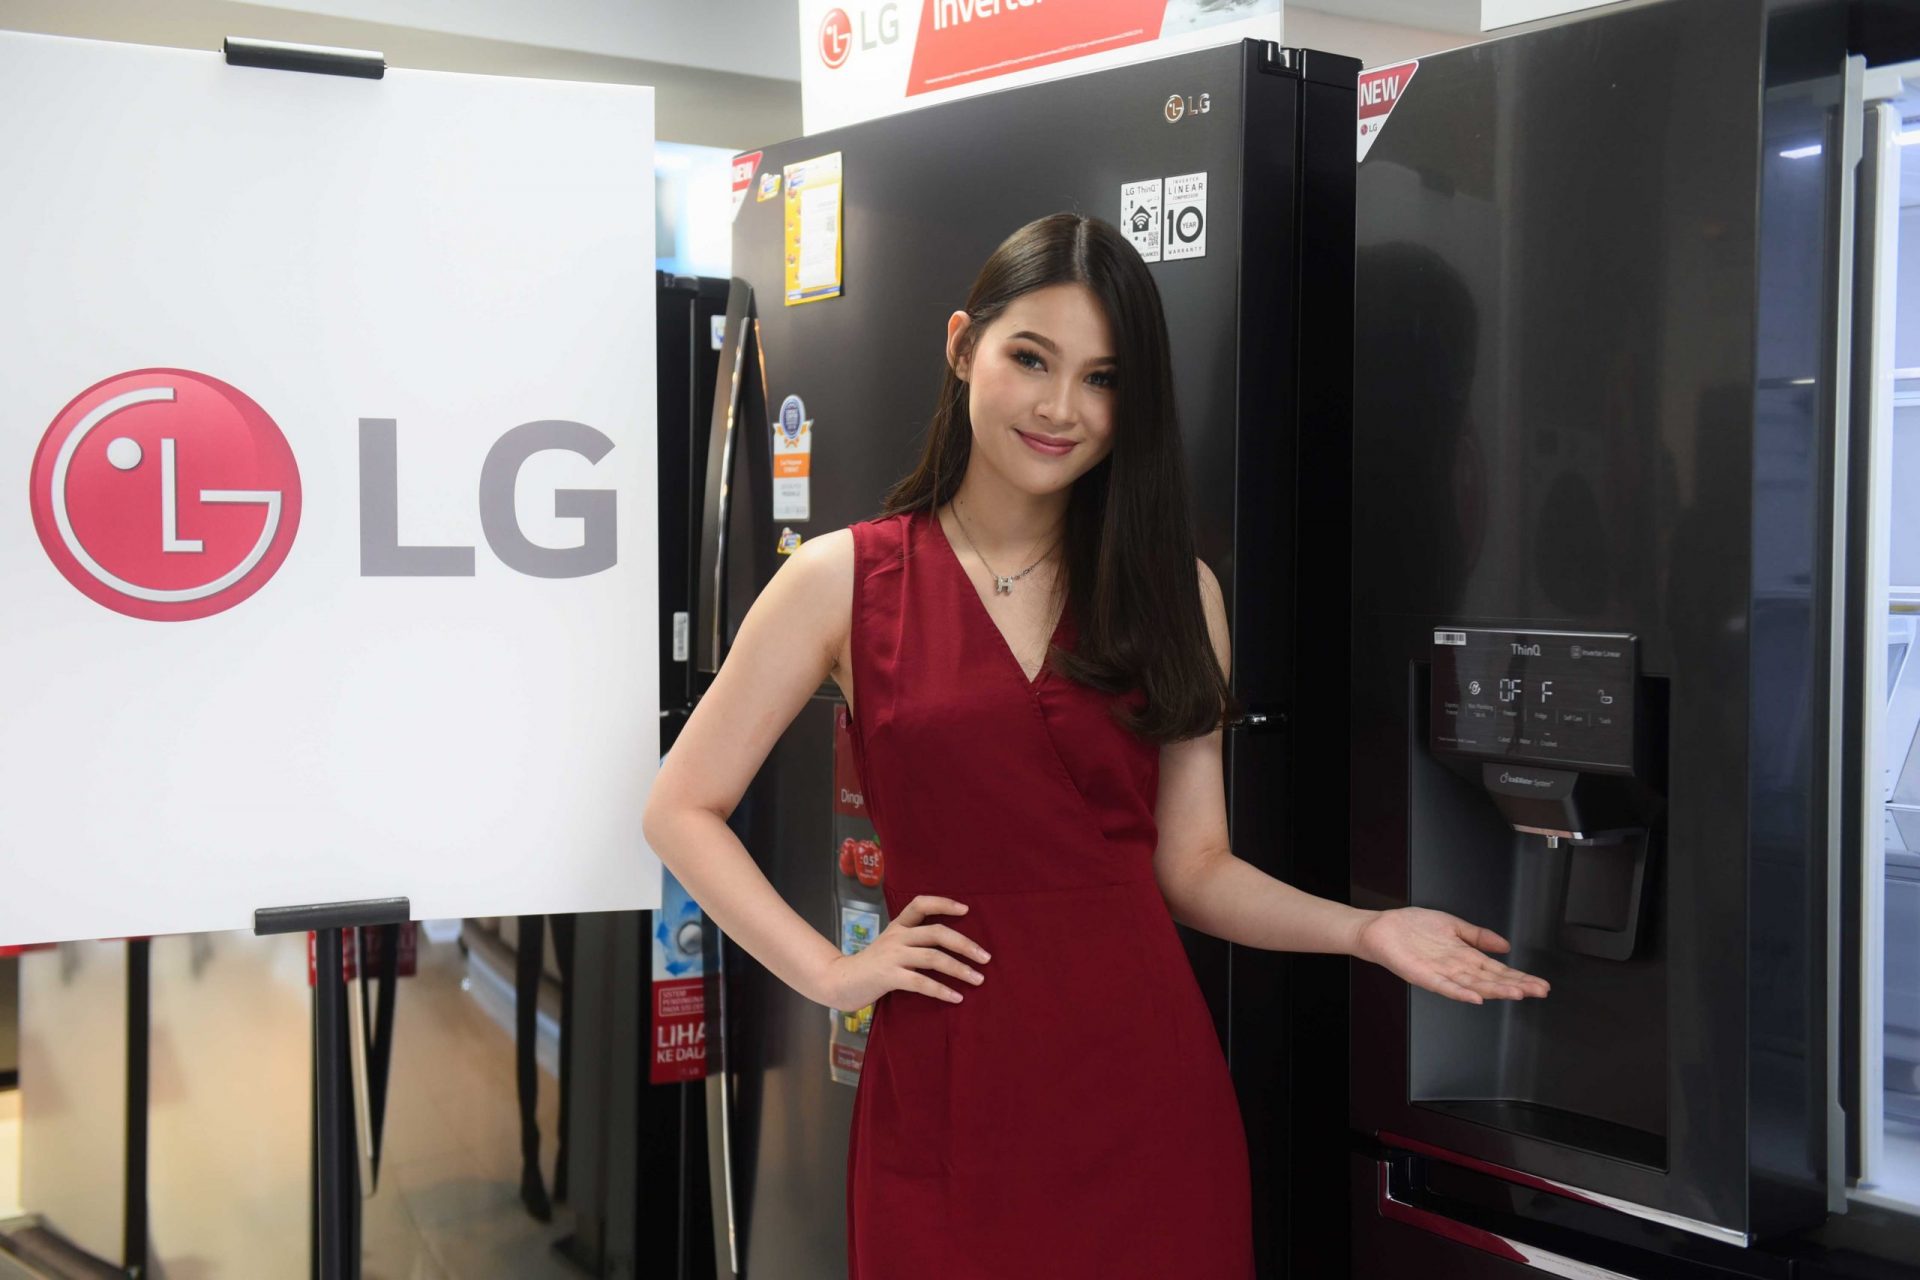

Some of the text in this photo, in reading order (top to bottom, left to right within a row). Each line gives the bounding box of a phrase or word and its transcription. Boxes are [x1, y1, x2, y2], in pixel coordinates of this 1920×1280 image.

[861, 3, 899, 51] LG
[1361, 75, 1399, 107] NEW
[1188, 93, 1210, 115] LG
[1126, 188, 1135, 196] LG
[1169, 182, 1204, 195] LINEAR
[1167, 206, 1204, 245] 10
[1182, 221, 1198, 230] YEAR
[358, 418, 618, 579] LG
[1511, 643, 1541, 657] ThinQ
[657, 1049, 673, 1063] KE
